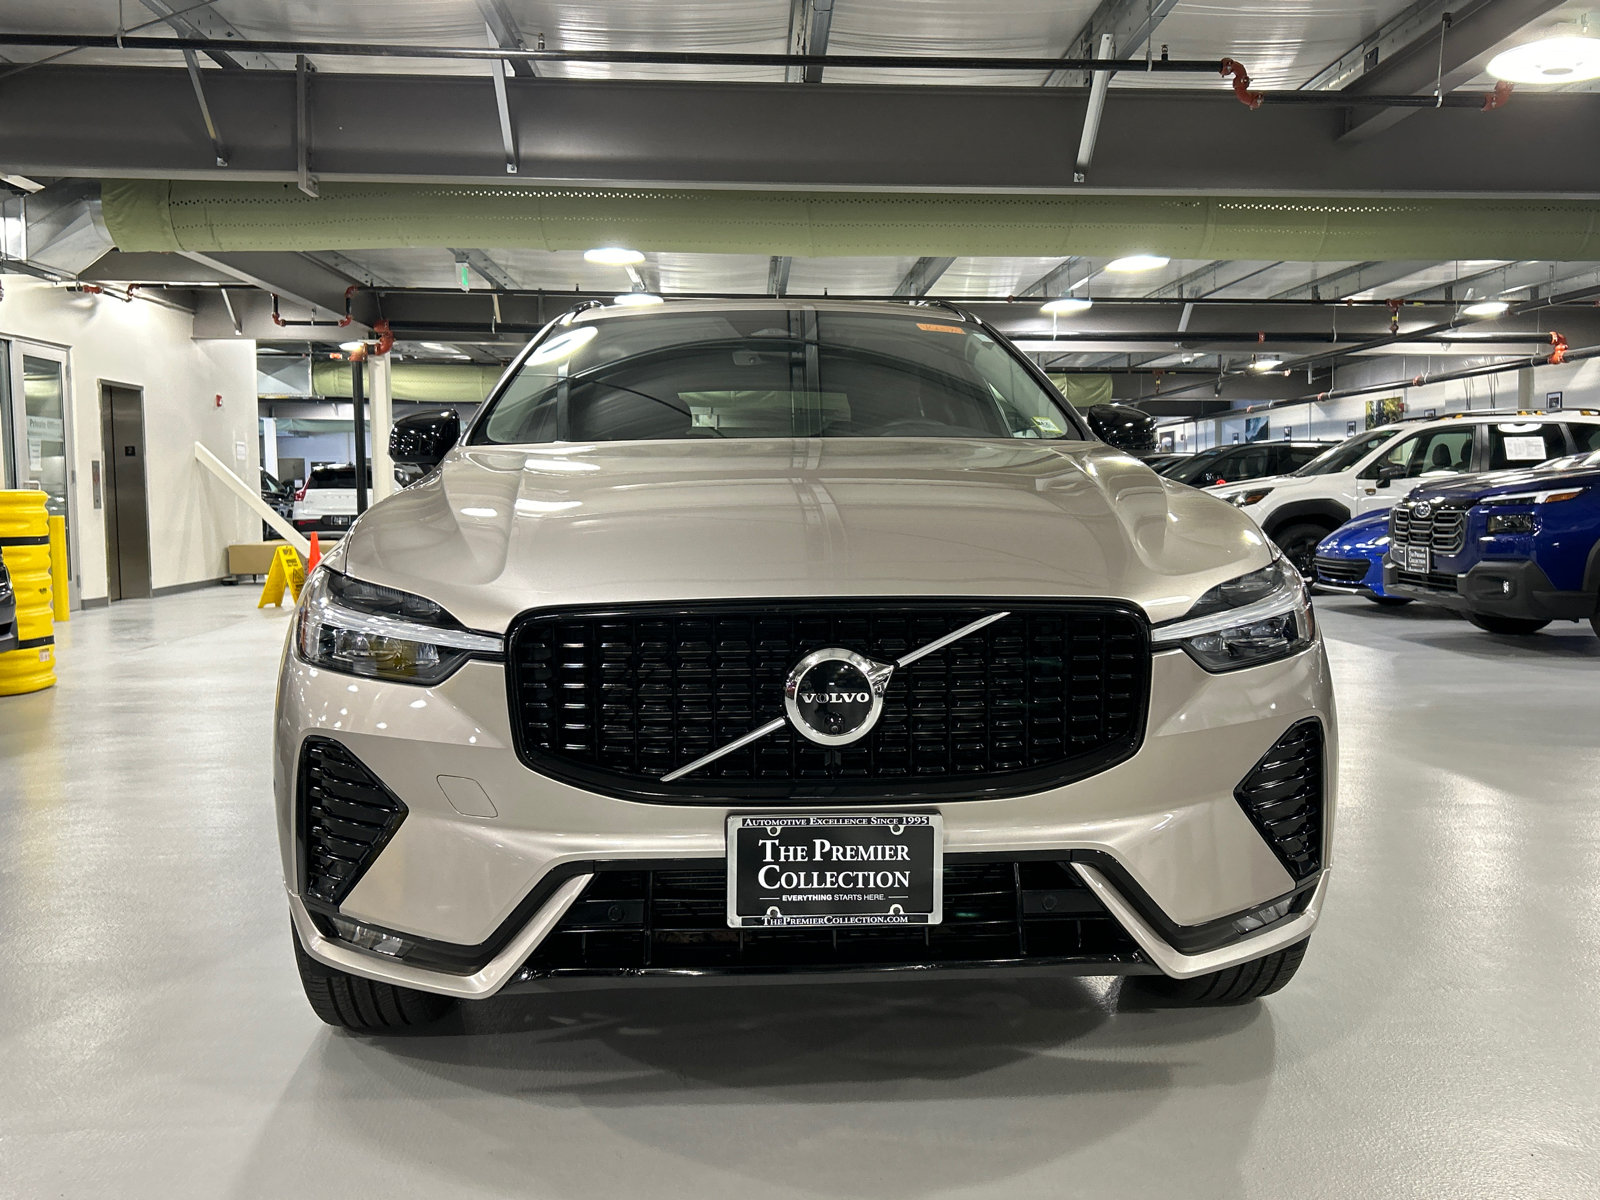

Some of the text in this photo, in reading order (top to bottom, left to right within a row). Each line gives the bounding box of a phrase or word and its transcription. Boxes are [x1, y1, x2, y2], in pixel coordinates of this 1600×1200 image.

[799, 692, 870, 704] VOLVO
[744, 816, 928, 827] AUTOMOTIVE EXCELLENCE SINCE 1995
[758, 838, 911, 862] THE PREMIER
[757, 864, 911, 890] COLLECTION
[782, 893, 886, 902] EVERYTHING STARTS HERE.
